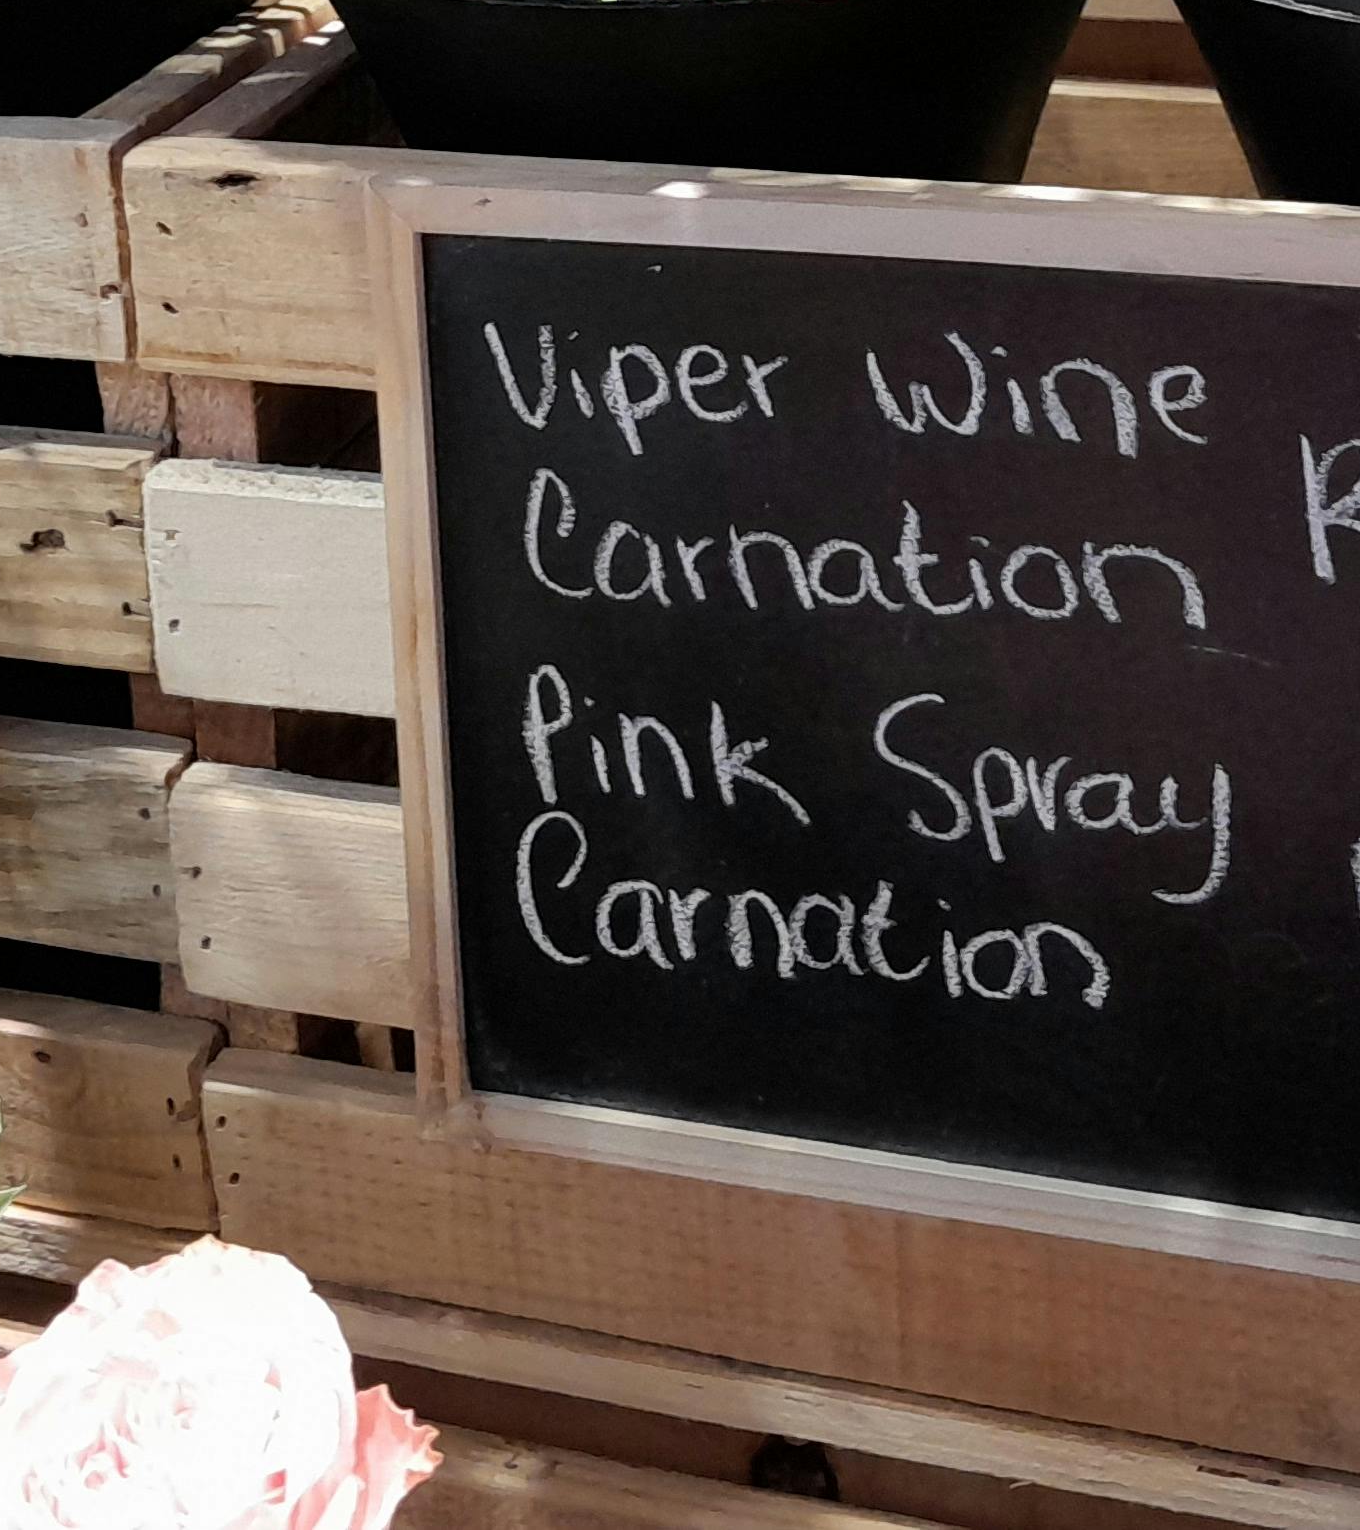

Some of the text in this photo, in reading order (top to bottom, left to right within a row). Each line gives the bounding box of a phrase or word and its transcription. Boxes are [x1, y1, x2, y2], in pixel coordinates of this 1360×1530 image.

[483, 321, 1209, 459] Viper Wine
[523, 468, 1207, 630] Carnation
[521, 663, 1233, 905] Pink Spray
[515, 810, 1111, 1010] Carnation
